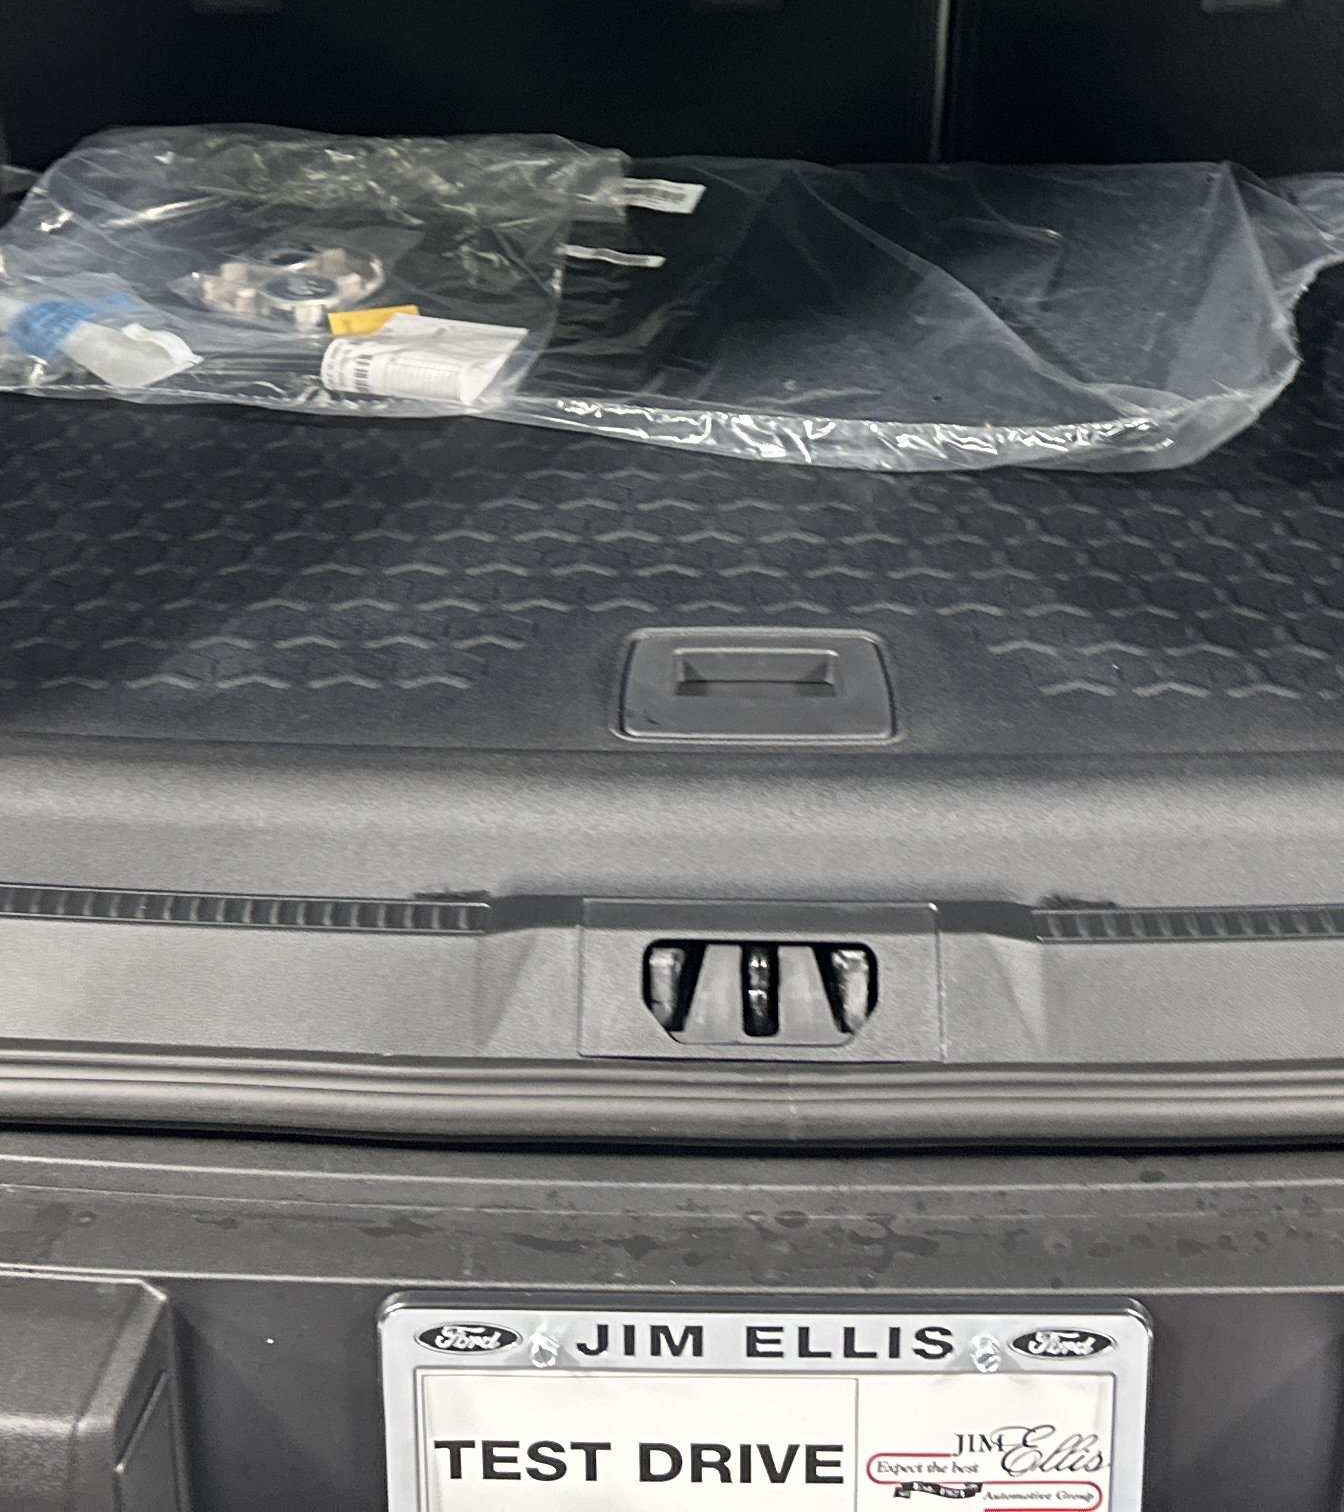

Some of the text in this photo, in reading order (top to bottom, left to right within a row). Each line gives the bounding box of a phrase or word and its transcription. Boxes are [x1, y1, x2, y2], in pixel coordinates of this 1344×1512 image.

[433, 1325, 506, 1350] Ford
[576, 1324, 955, 1360] JIM ELLIS
[1027, 1330, 1098, 1355] Ford
[433, 1440, 845, 1485] TEST DRIVE
[953, 1424, 1106, 1477] JIM Ellis
[876, 1460, 979, 1476] Expect the best
[983, 1490, 1052, 1502] Automotive
